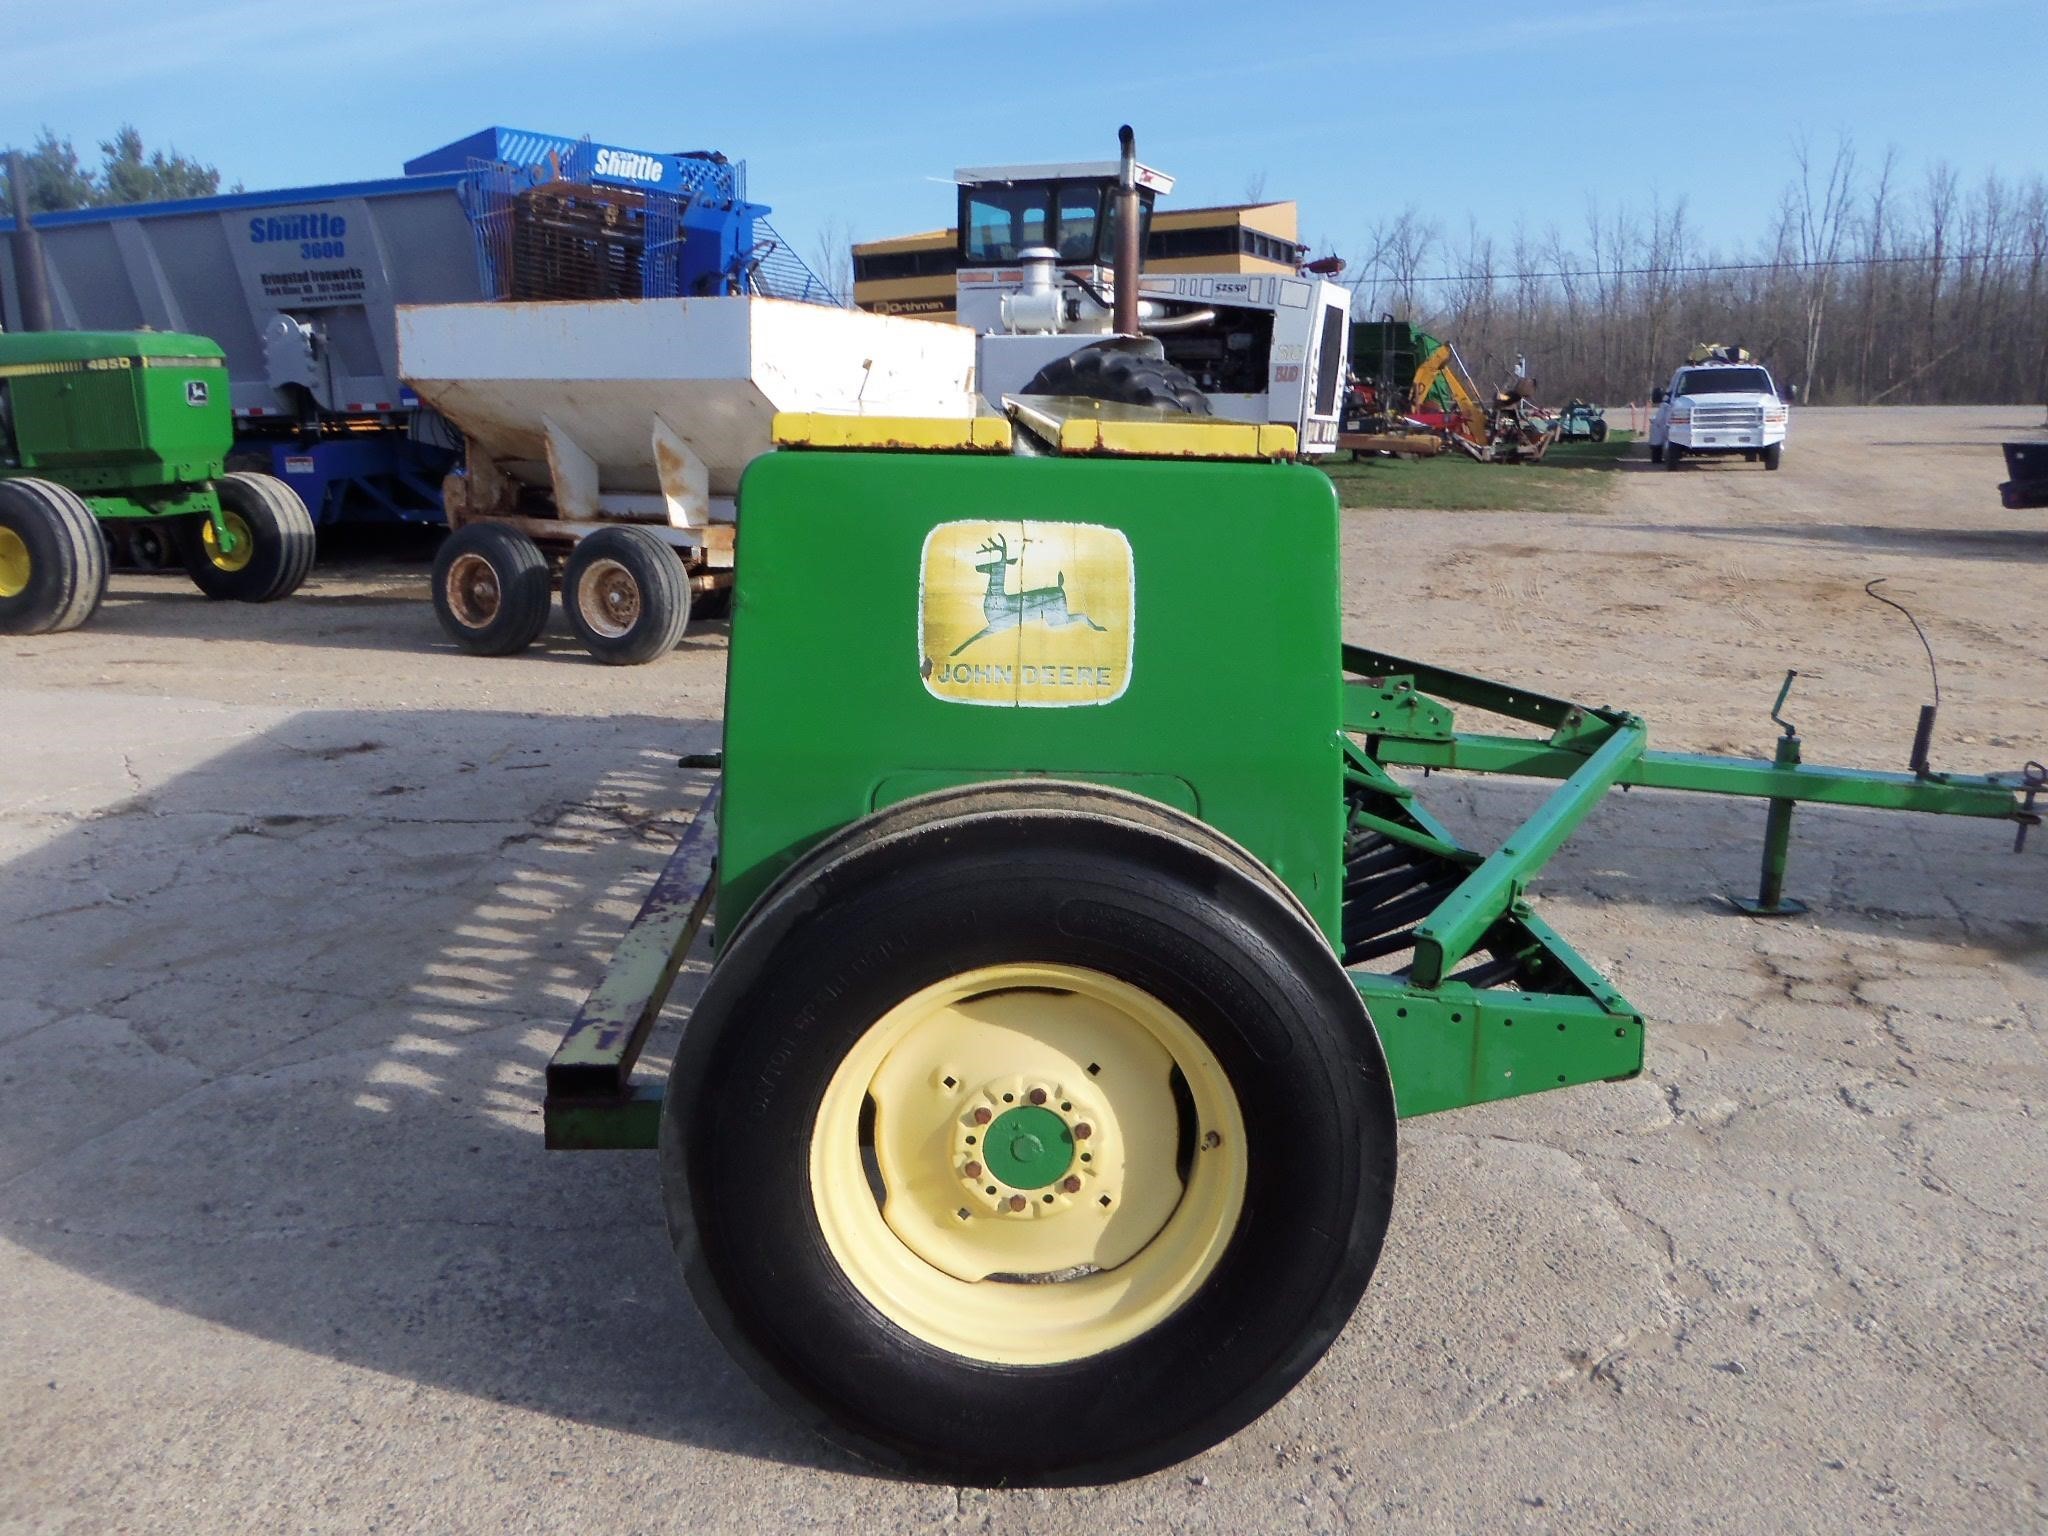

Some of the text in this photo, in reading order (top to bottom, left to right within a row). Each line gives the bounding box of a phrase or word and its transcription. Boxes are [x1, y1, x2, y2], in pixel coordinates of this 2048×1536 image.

[595, 149, 664, 182] Shuttle
[250, 212, 346, 243] Shuttle
[889, 301, 945, 313] Orthman
[937, 662, 1112, 686] JOHN DEERE
